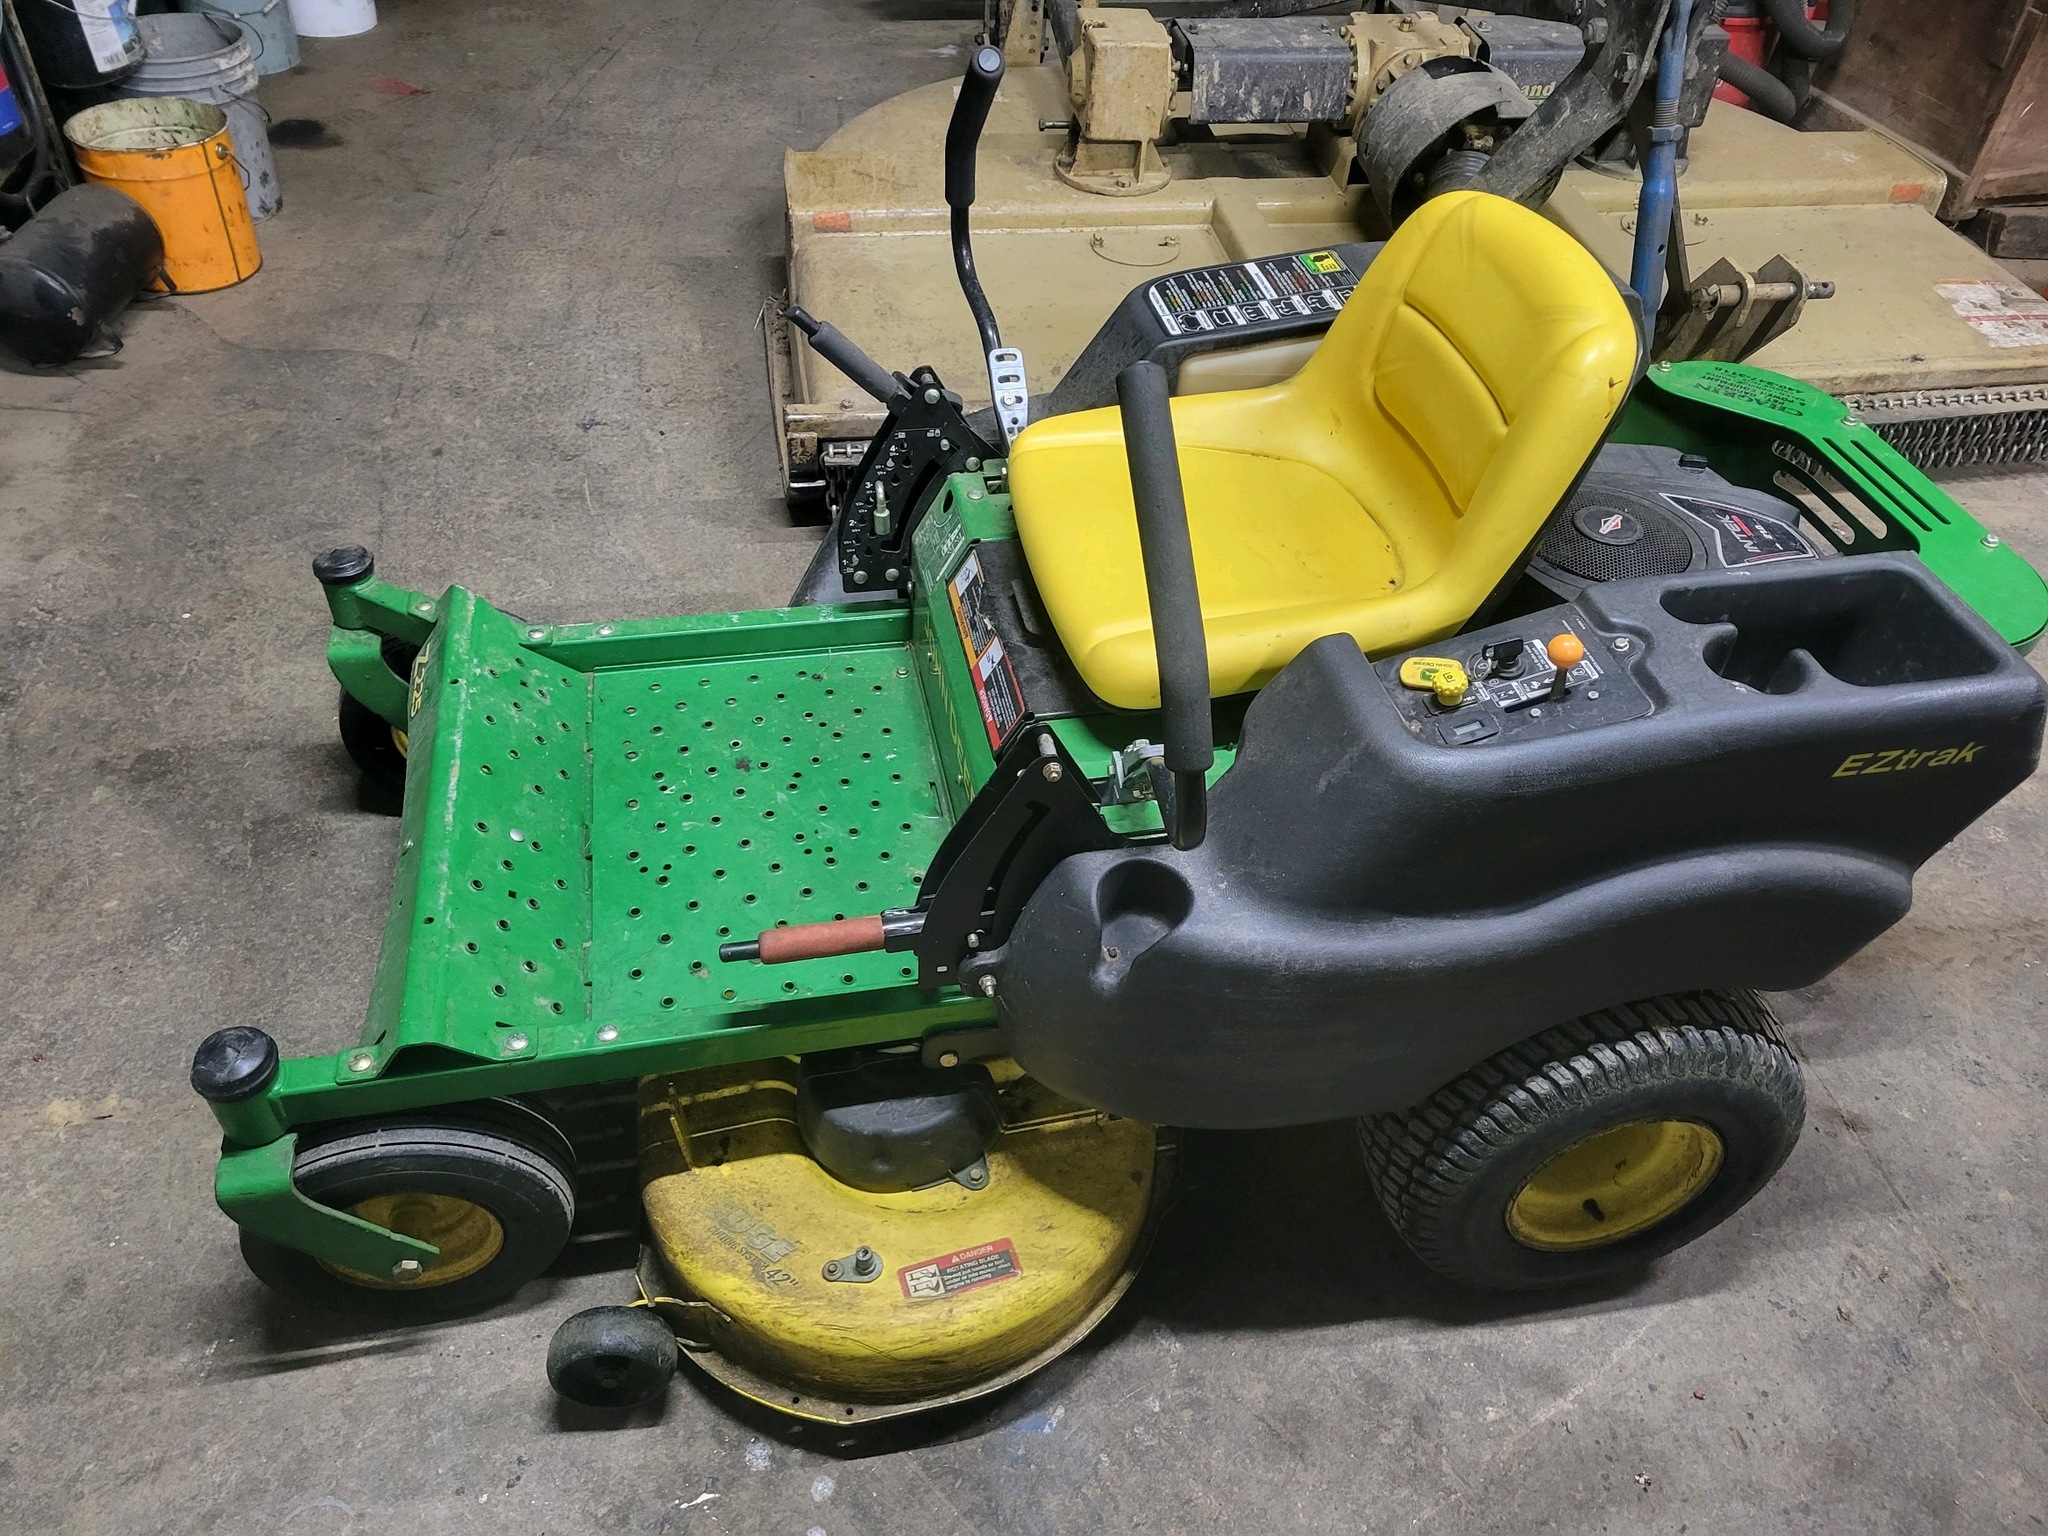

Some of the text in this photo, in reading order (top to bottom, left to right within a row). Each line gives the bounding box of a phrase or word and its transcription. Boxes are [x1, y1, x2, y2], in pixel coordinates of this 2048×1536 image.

[1694, 381, 1804, 416] CHAGRIN
[1701, 375, 1757, 392] EQUIPMENT
[1707, 509, 1762, 553] INTEK
[410, 642, 430, 718] Z225
[978, 685, 991, 718] DANGER
[1831, 741, 1987, 778] EZtrak
[711, 1203, 799, 1264] DGE
[706, 1225, 799, 1287] CUTTING SYSTM 42"
[946, 1253, 1000, 1273] ROTATING BLADE
[959, 1245, 994, 1260] DANGER
